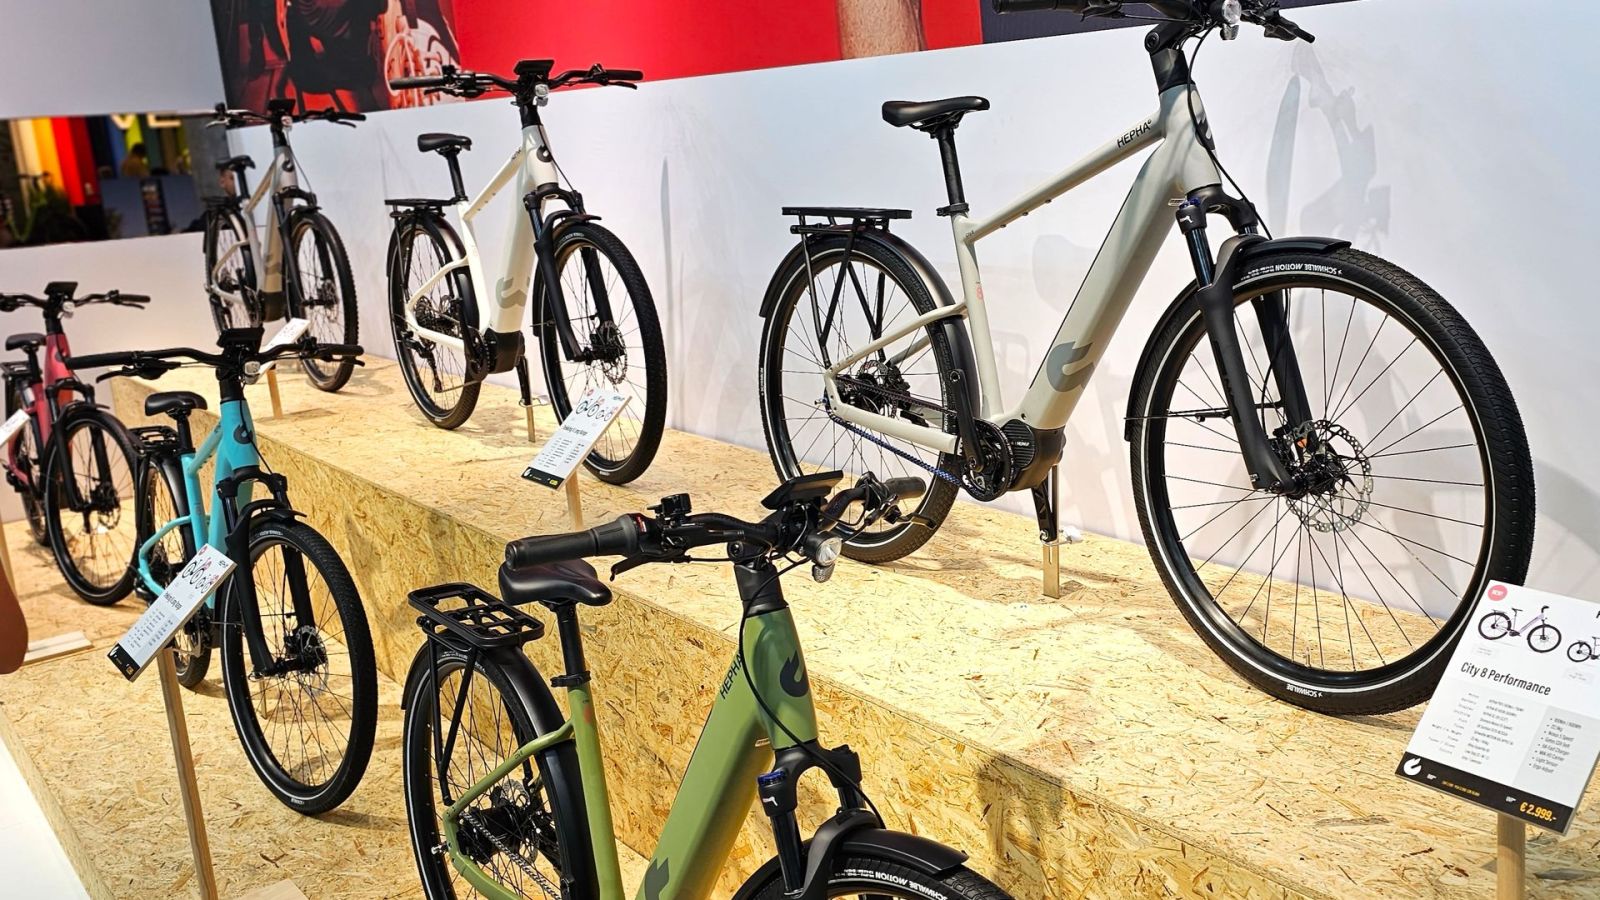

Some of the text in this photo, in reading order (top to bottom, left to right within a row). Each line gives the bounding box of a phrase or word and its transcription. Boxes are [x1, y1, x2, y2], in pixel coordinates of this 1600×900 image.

[1117, 121, 1151, 148] HEPHA
[1275, 263, 1338, 275] SCHWALBE MOTION
[1461, 662, 1551, 696] City 8 Performance
[1519, 802, 1529, 813] €
[875, 871, 908, 885] MOTION
